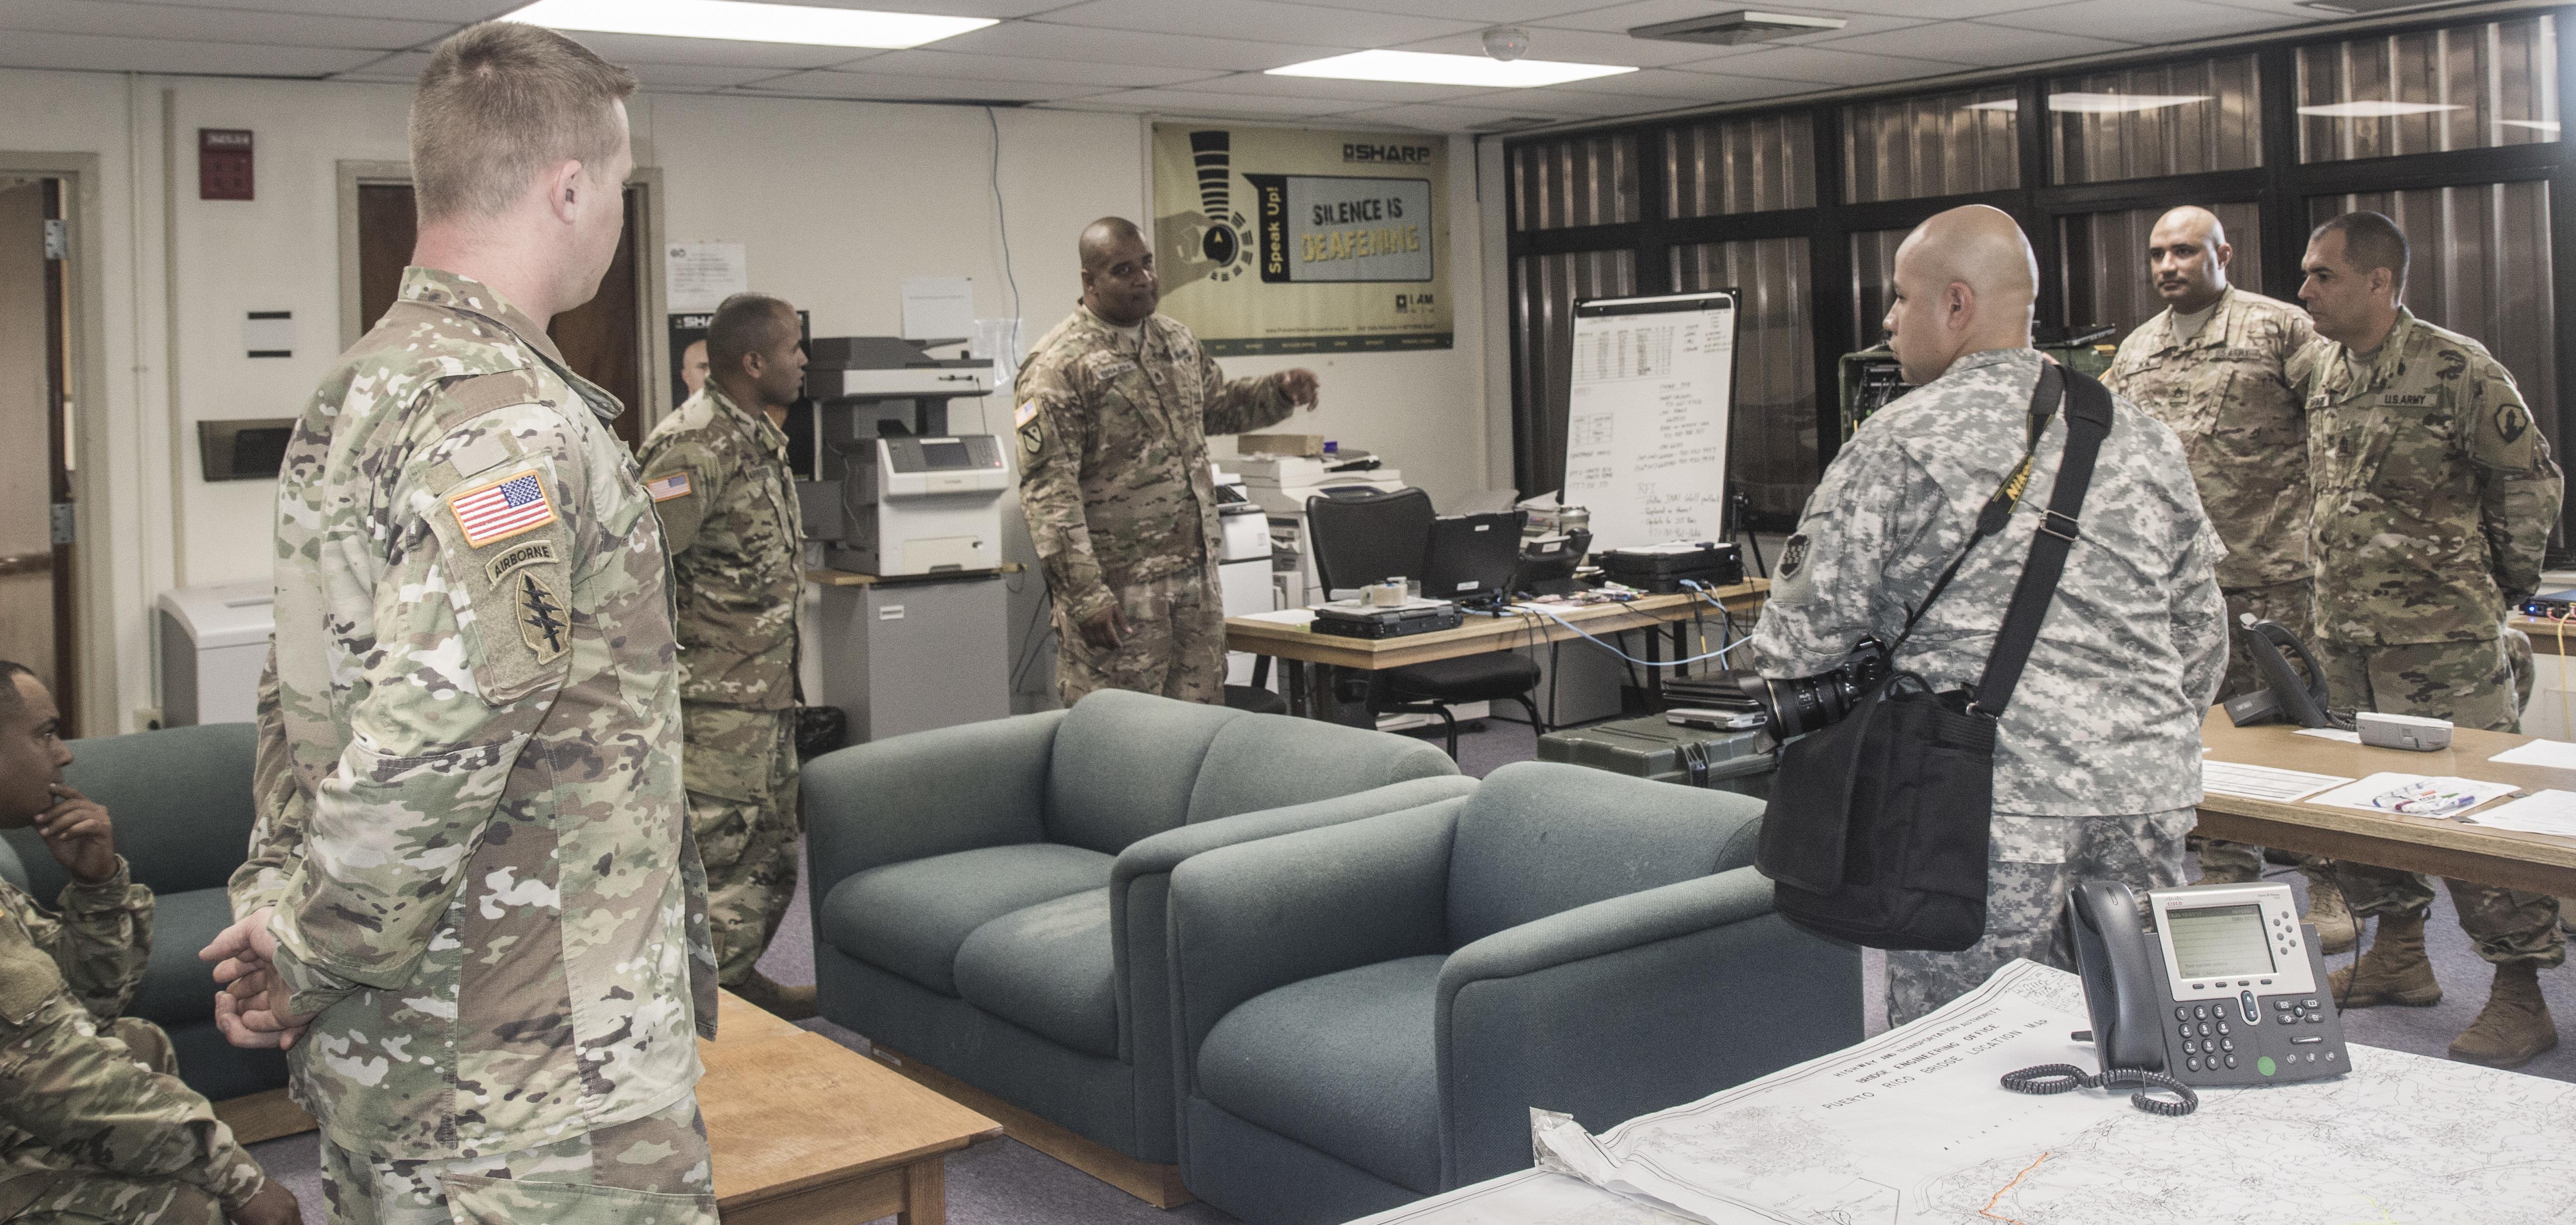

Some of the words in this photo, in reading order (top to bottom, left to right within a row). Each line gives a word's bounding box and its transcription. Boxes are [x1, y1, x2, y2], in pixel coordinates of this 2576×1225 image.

[1356, 145, 1430, 161] SHARP
[1266, 186, 1281, 216] Up!
[1312, 199, 1382, 225] SILENCE
[1387, 197, 1403, 219] IS
[1268, 222, 1283, 274] Speak
[1301, 225, 1420, 262] DEAFENING
[683, 316, 713, 328] SHA
[2399, 395, 2427, 404] ARMY
[494, 546, 550, 577] AIRBORNE
[1834, 1059, 1877, 1077] HIGHWAY
[1881, 1052, 1896, 1060] AND
[1895, 1025, 1959, 1053] TRANSPORTATION
[1960, 1007, 2002, 1027] AUTHORITY
[1856, 1069, 1892, 1084] BRIDGE
[1893, 1042, 1960, 1069] ENGINEERING
[1963, 1023, 2000, 1041] OFFICE
[1821, 1091, 1875, 1109] PUERTO
[1882, 1076, 1915, 1088] RICO
[1920, 1056, 1963, 1074] BRIDGE
[1966, 1029, 2022, 1055] LOCATION
[2024, 1019, 2048, 1029] MAP
